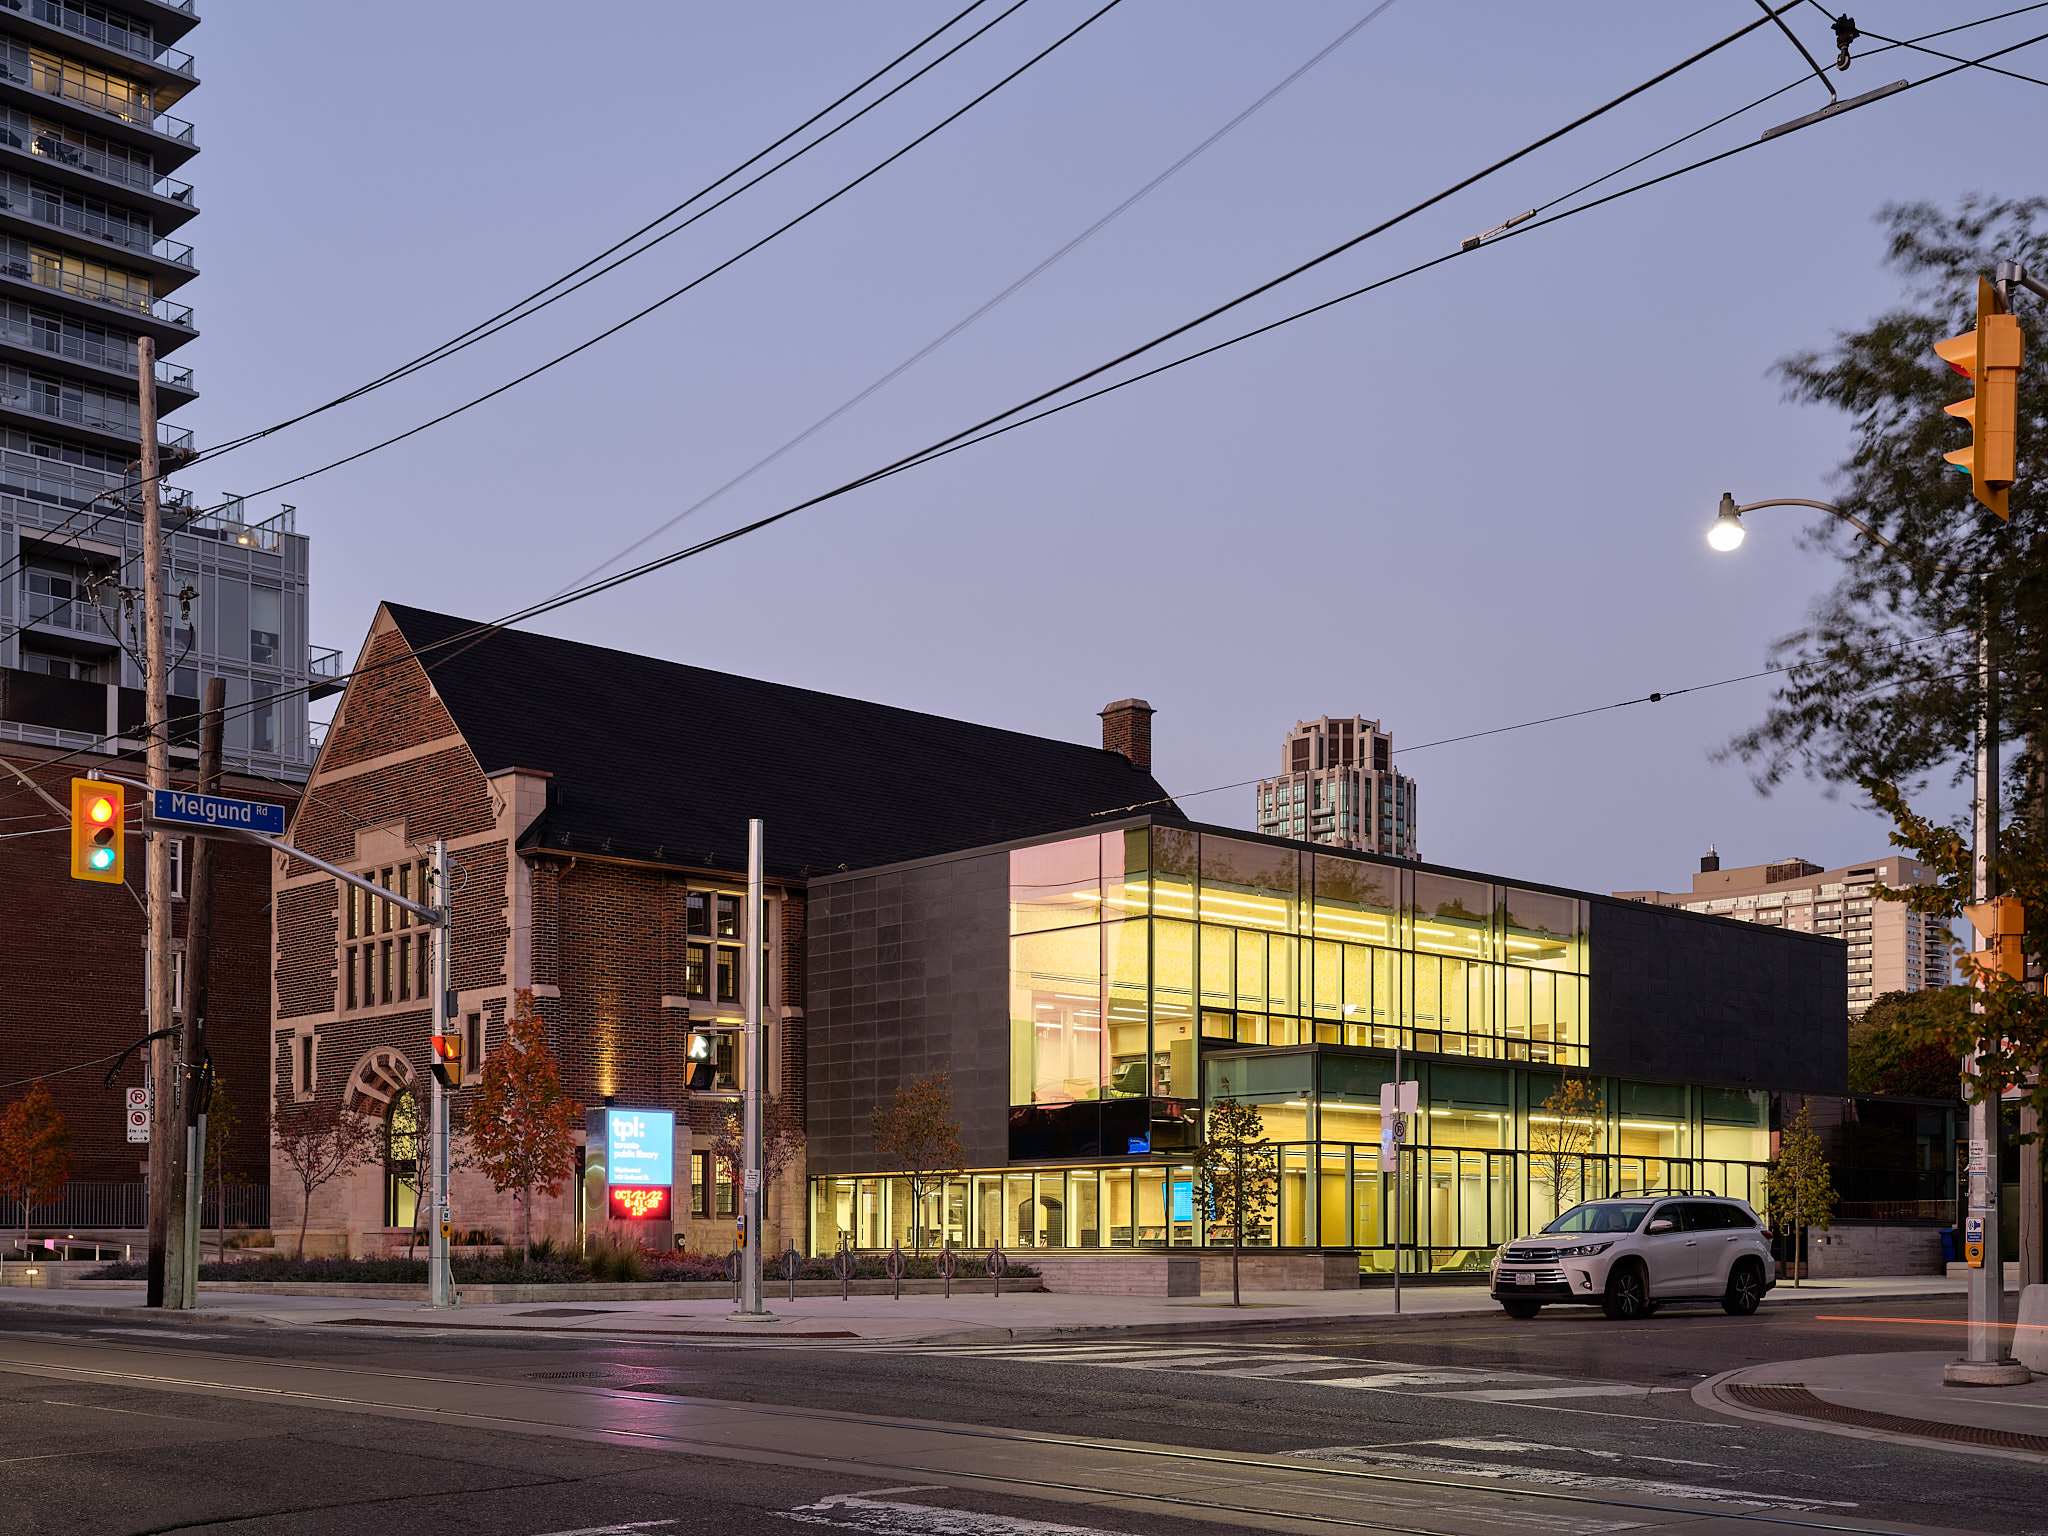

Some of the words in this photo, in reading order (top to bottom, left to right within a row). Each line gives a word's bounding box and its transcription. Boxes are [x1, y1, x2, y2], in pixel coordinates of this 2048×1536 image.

[172, 793, 251, 823] Melgund
[256, 805, 268, 816] Rd
[614, 1141, 639, 1149] toronto
[614, 1150, 635, 1159] public
[636, 1150, 658, 1160] library
[615, 1190, 662, 1200] OCT/21/22
